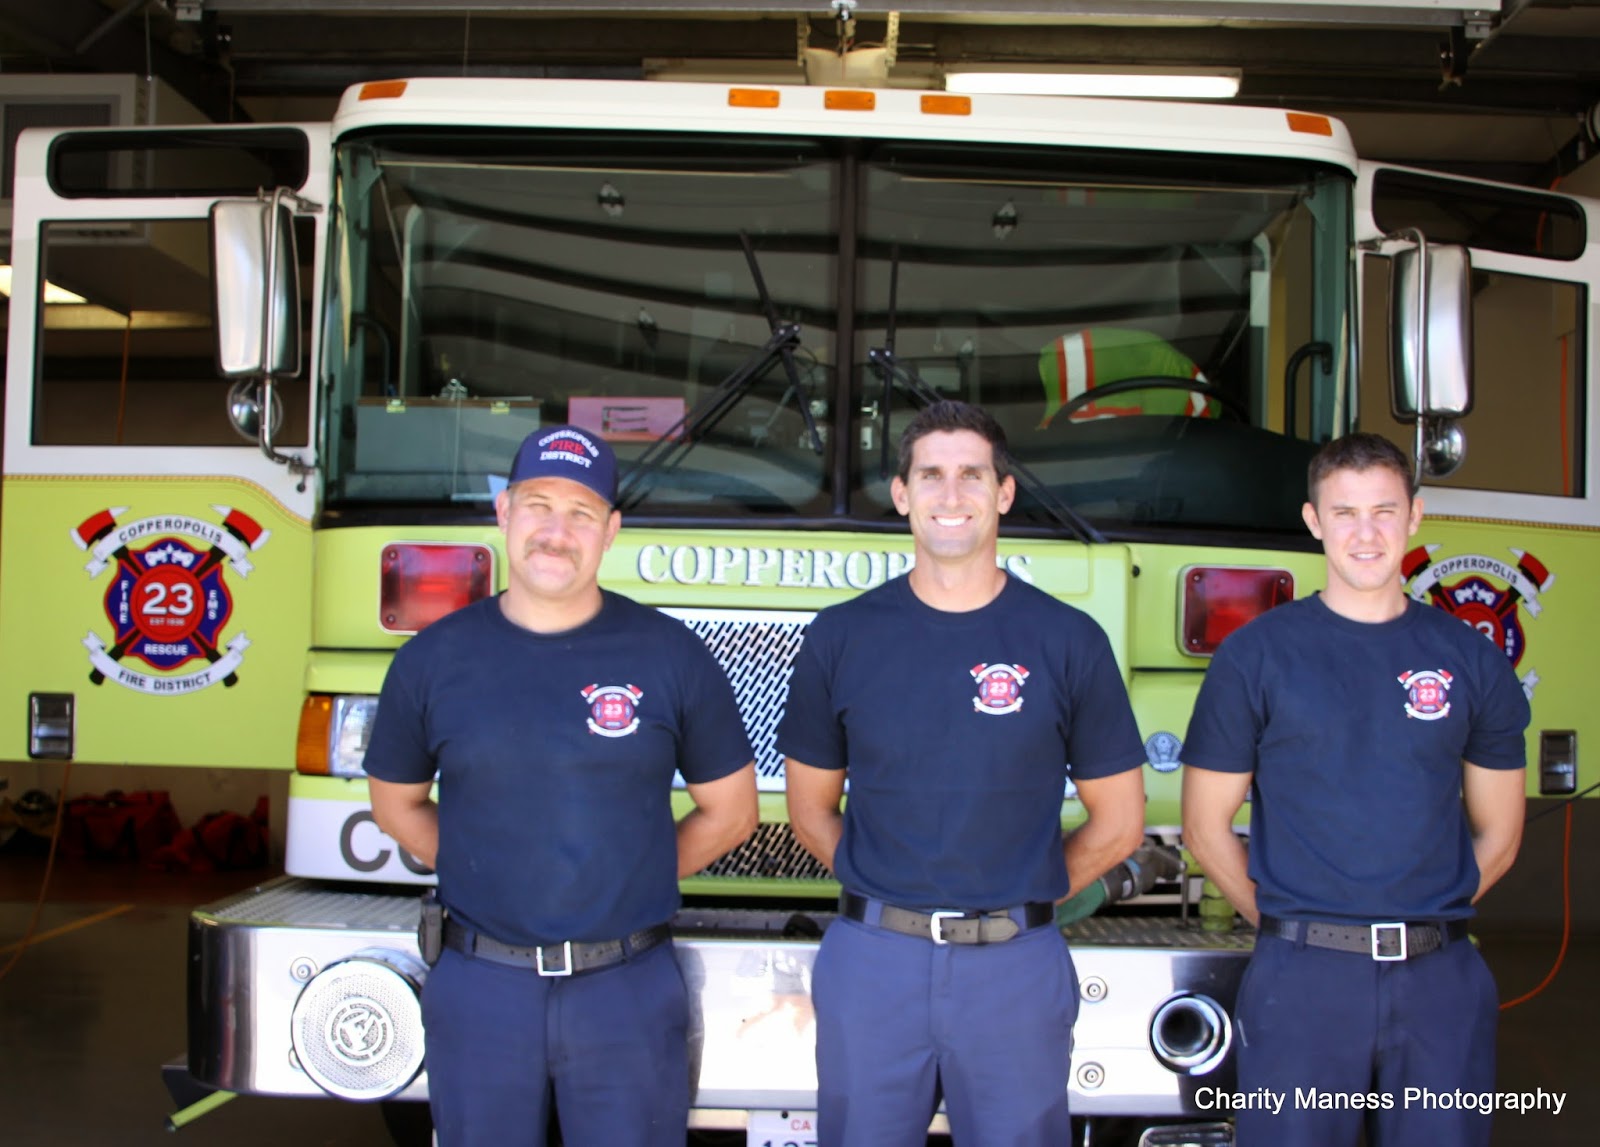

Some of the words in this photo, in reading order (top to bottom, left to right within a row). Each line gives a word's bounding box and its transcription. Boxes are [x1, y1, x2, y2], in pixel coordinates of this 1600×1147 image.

[538, 429, 599, 458] COPPEROPOLIS
[549, 439, 585, 456] FIRE
[540, 450, 592, 468] DISTRICT
[118, 518, 222, 543] COPPEROPOLIS
[637, 544, 1033, 590] COPPEROPS
[1432, 557, 1518, 585] COPPEROPOLIS
[119, 580, 129, 624] FIRE
[142, 582, 194, 616] 23
[207, 590, 219, 620] EMS
[144, 643, 188, 656] RESCUE
[1505, 628, 1515, 657] EMS
[118, 670, 146, 689] FIRE
[153, 672, 212, 691] DISTRICT
[990, 681, 1009, 694] 23
[1420, 688, 1437, 700] 23
[604, 703, 623, 715] 23
[790, 1119, 811, 1131] CA
